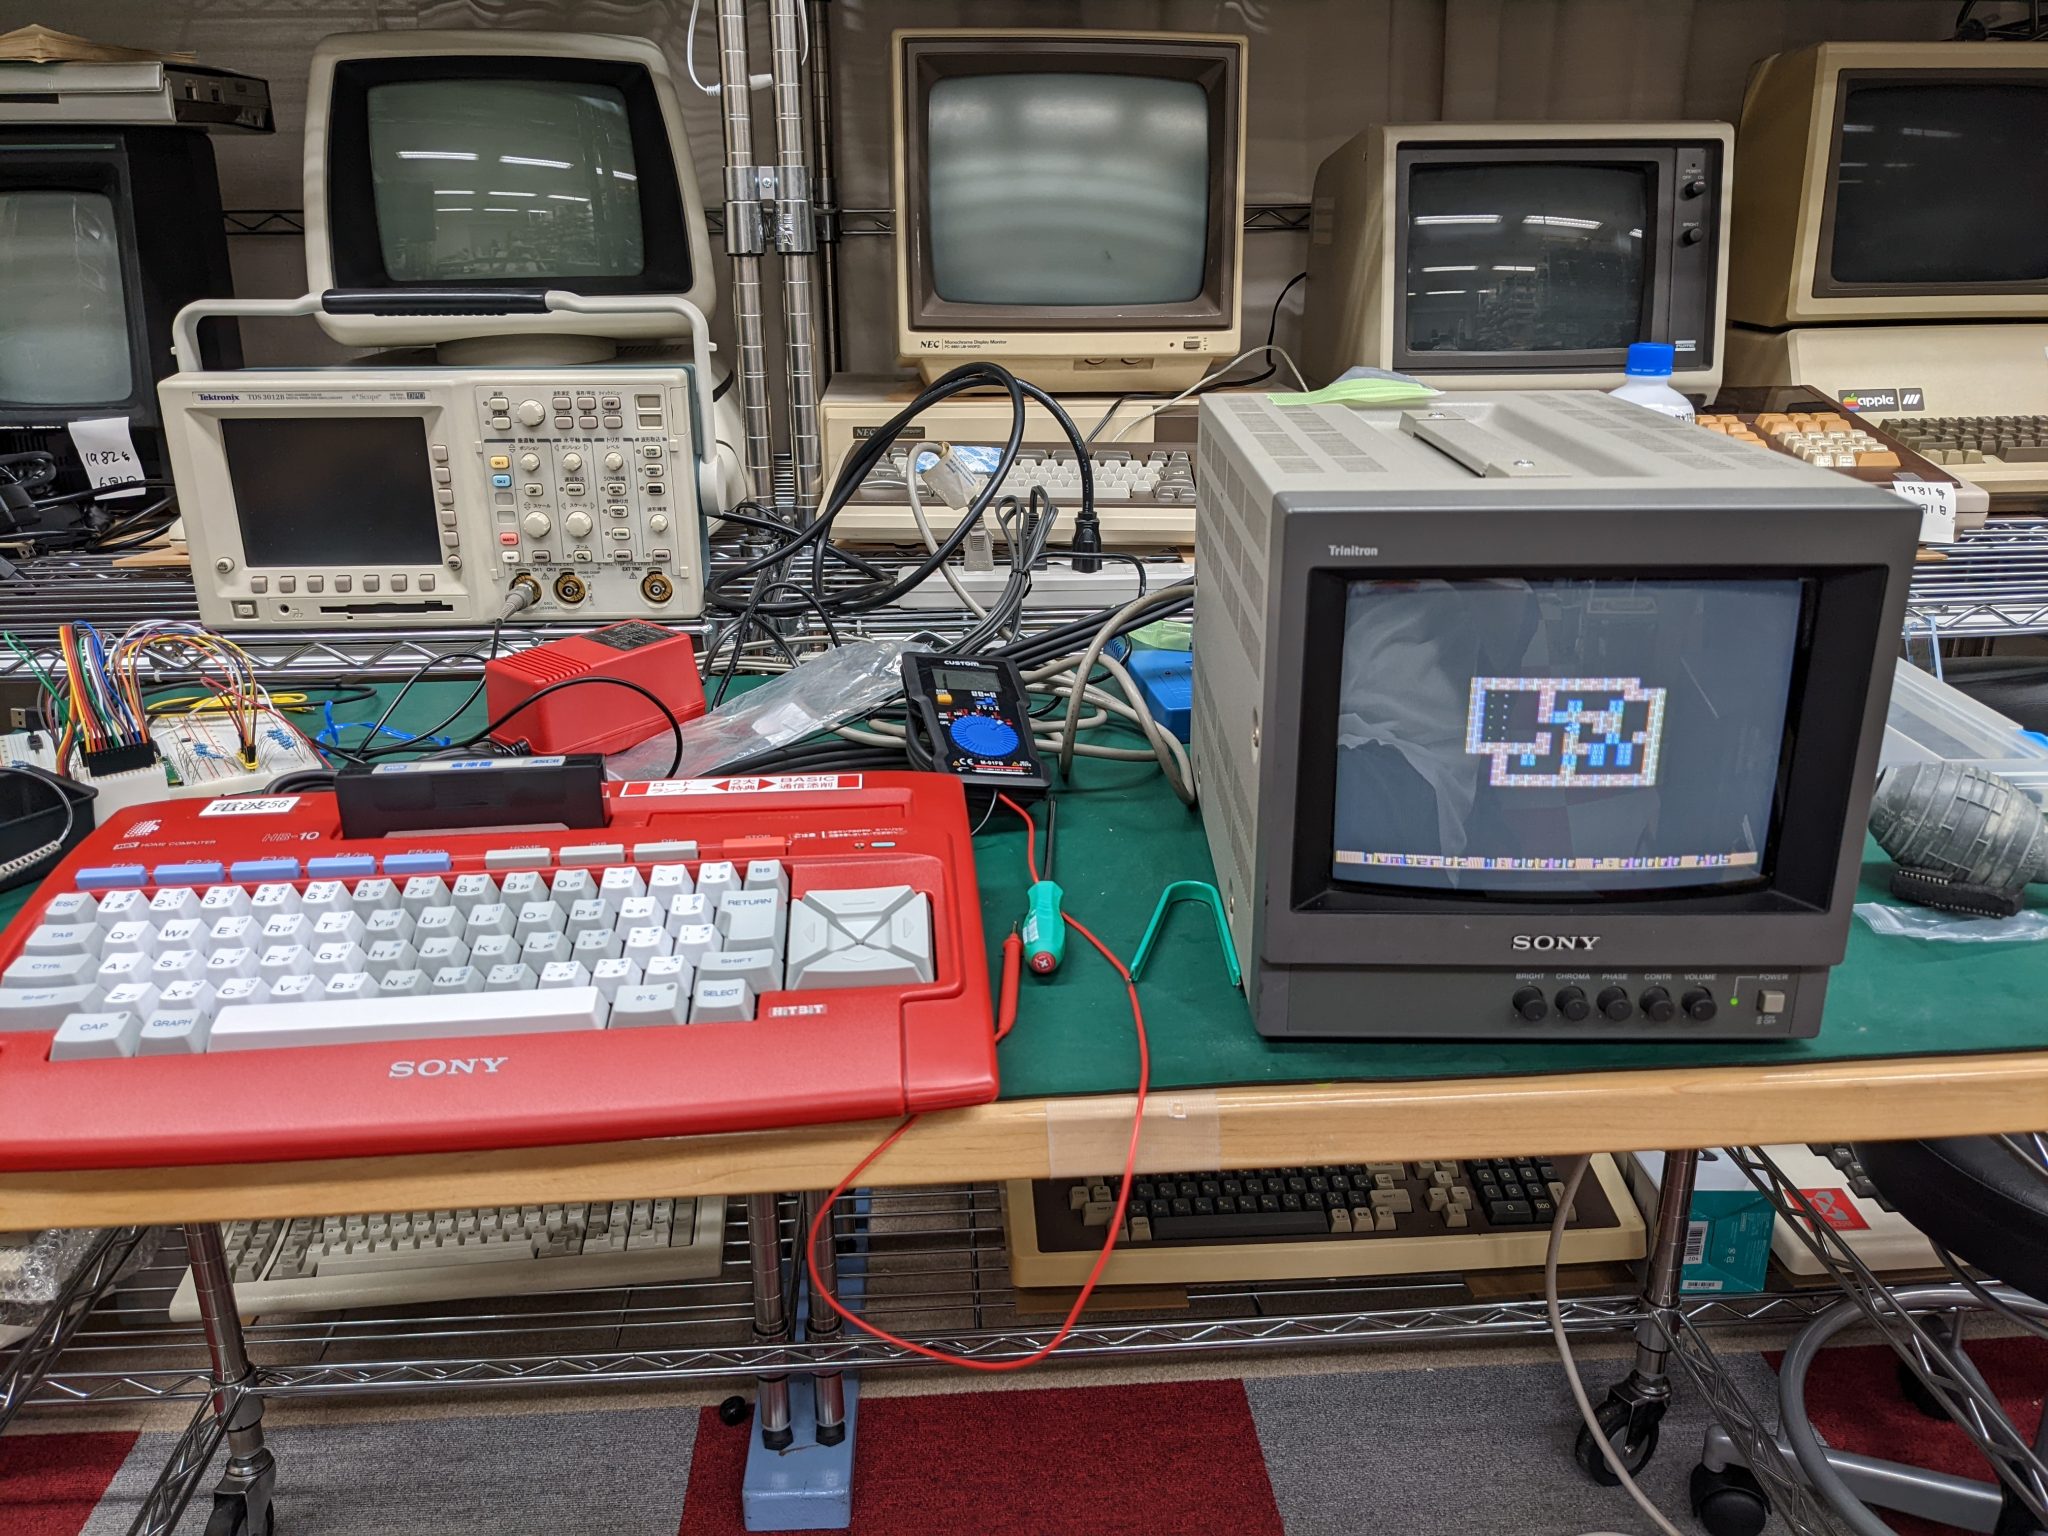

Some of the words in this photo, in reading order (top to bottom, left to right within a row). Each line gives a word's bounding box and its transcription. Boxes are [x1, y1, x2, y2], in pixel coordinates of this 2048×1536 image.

[920, 340, 939, 348] NEC
[1858, 395, 1895, 407] apple
[857, 428, 875, 436] NEC
[1328, 545, 1379, 556] Trinitron
[212, 800, 289, 812] 電波56
[728, 898, 772, 906] RETURN
[1512, 935, 1600, 950] SONY
[704, 988, 740, 997] SELECT
[22, 993, 59, 1001] SHIFT
[80, 1023, 110, 1031] CAP
[152, 1019, 193, 1027] GRAPH
[388, 1056, 509, 1078] SONY
